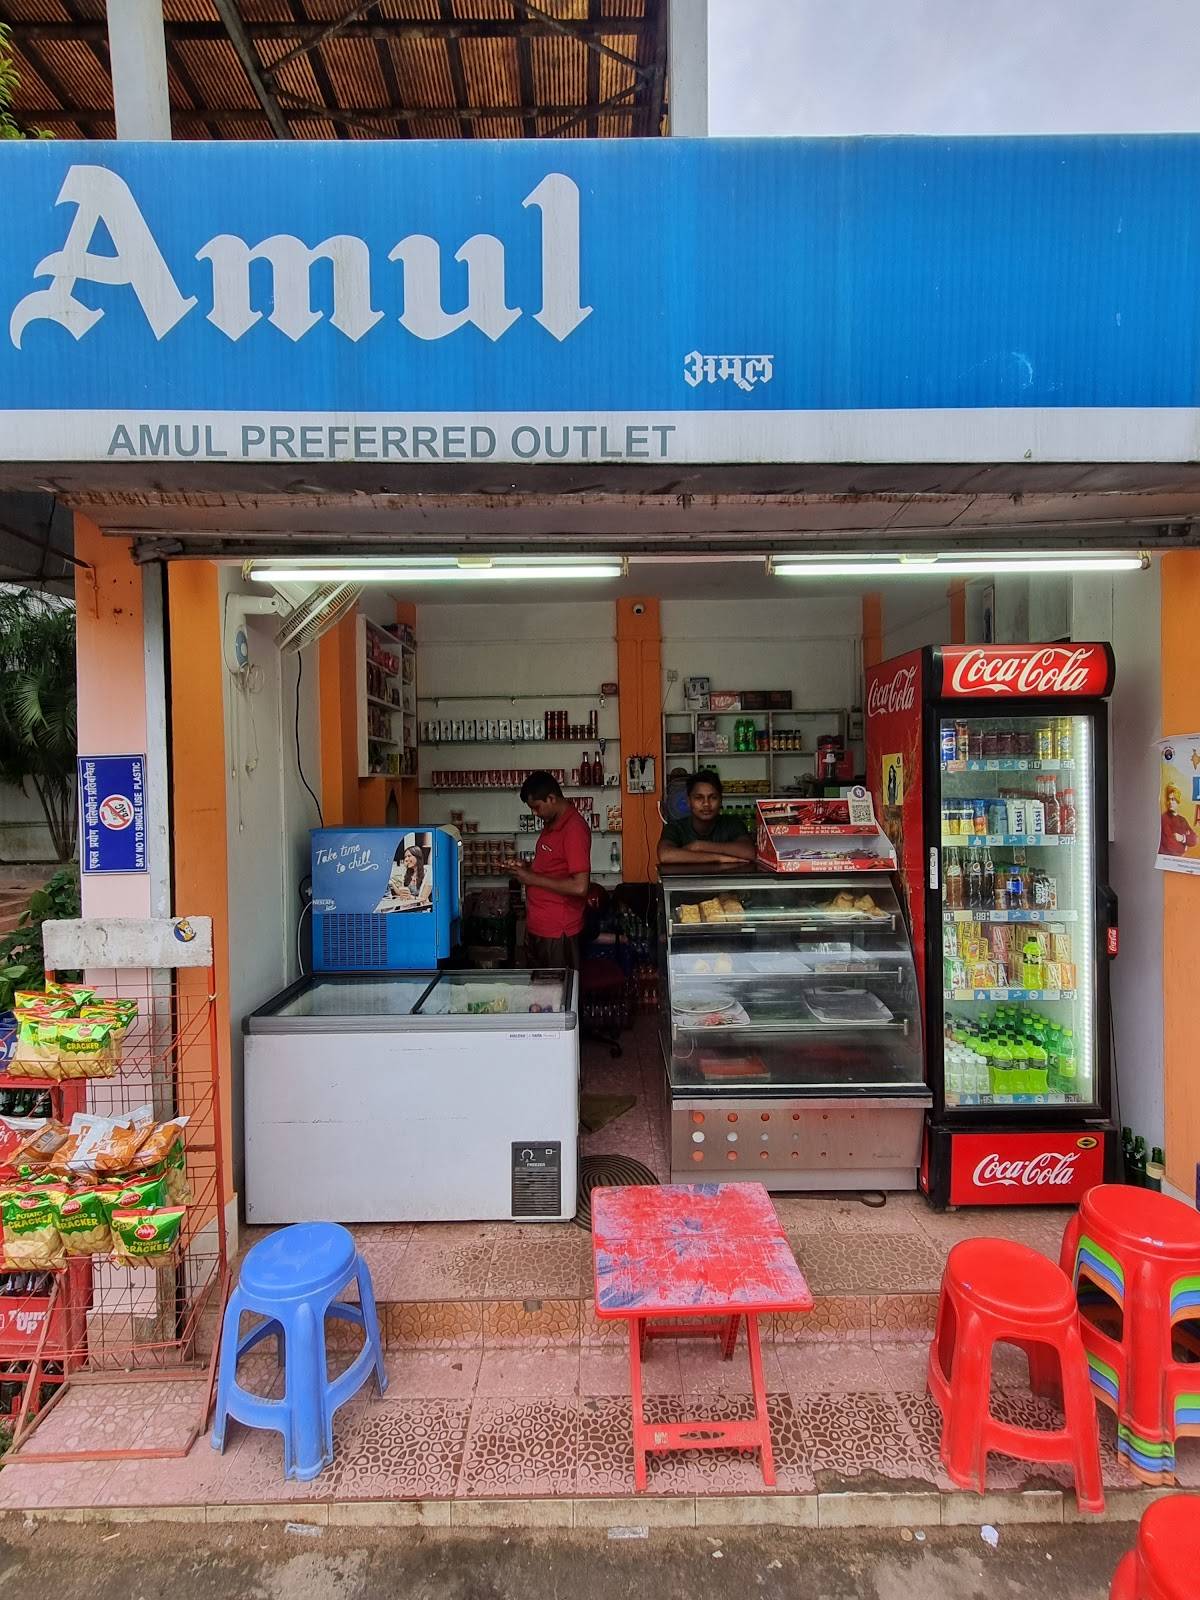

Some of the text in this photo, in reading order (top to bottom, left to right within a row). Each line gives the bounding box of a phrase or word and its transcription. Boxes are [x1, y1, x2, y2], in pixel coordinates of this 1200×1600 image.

[10, 165, 593, 350] Amul
[684, 350, 774, 392] अमूल
[108, 425, 676, 458] AMUL PREFERRED OUTLET
[952, 647, 1095, 693] Coca-Cola
[868, 664, 918, 718] Coca-Cola
[132, 762, 144, 868] SAY NO TO SINGLE USE PLASTIC
[89, 850, 100, 869] एकल
[316, 843, 360, 865] Take time
[336, 849, 371, 874] to chill
[972, 1152, 1080, 1186] Coca-Cola
[16, 1320, 38, 1334] Up
